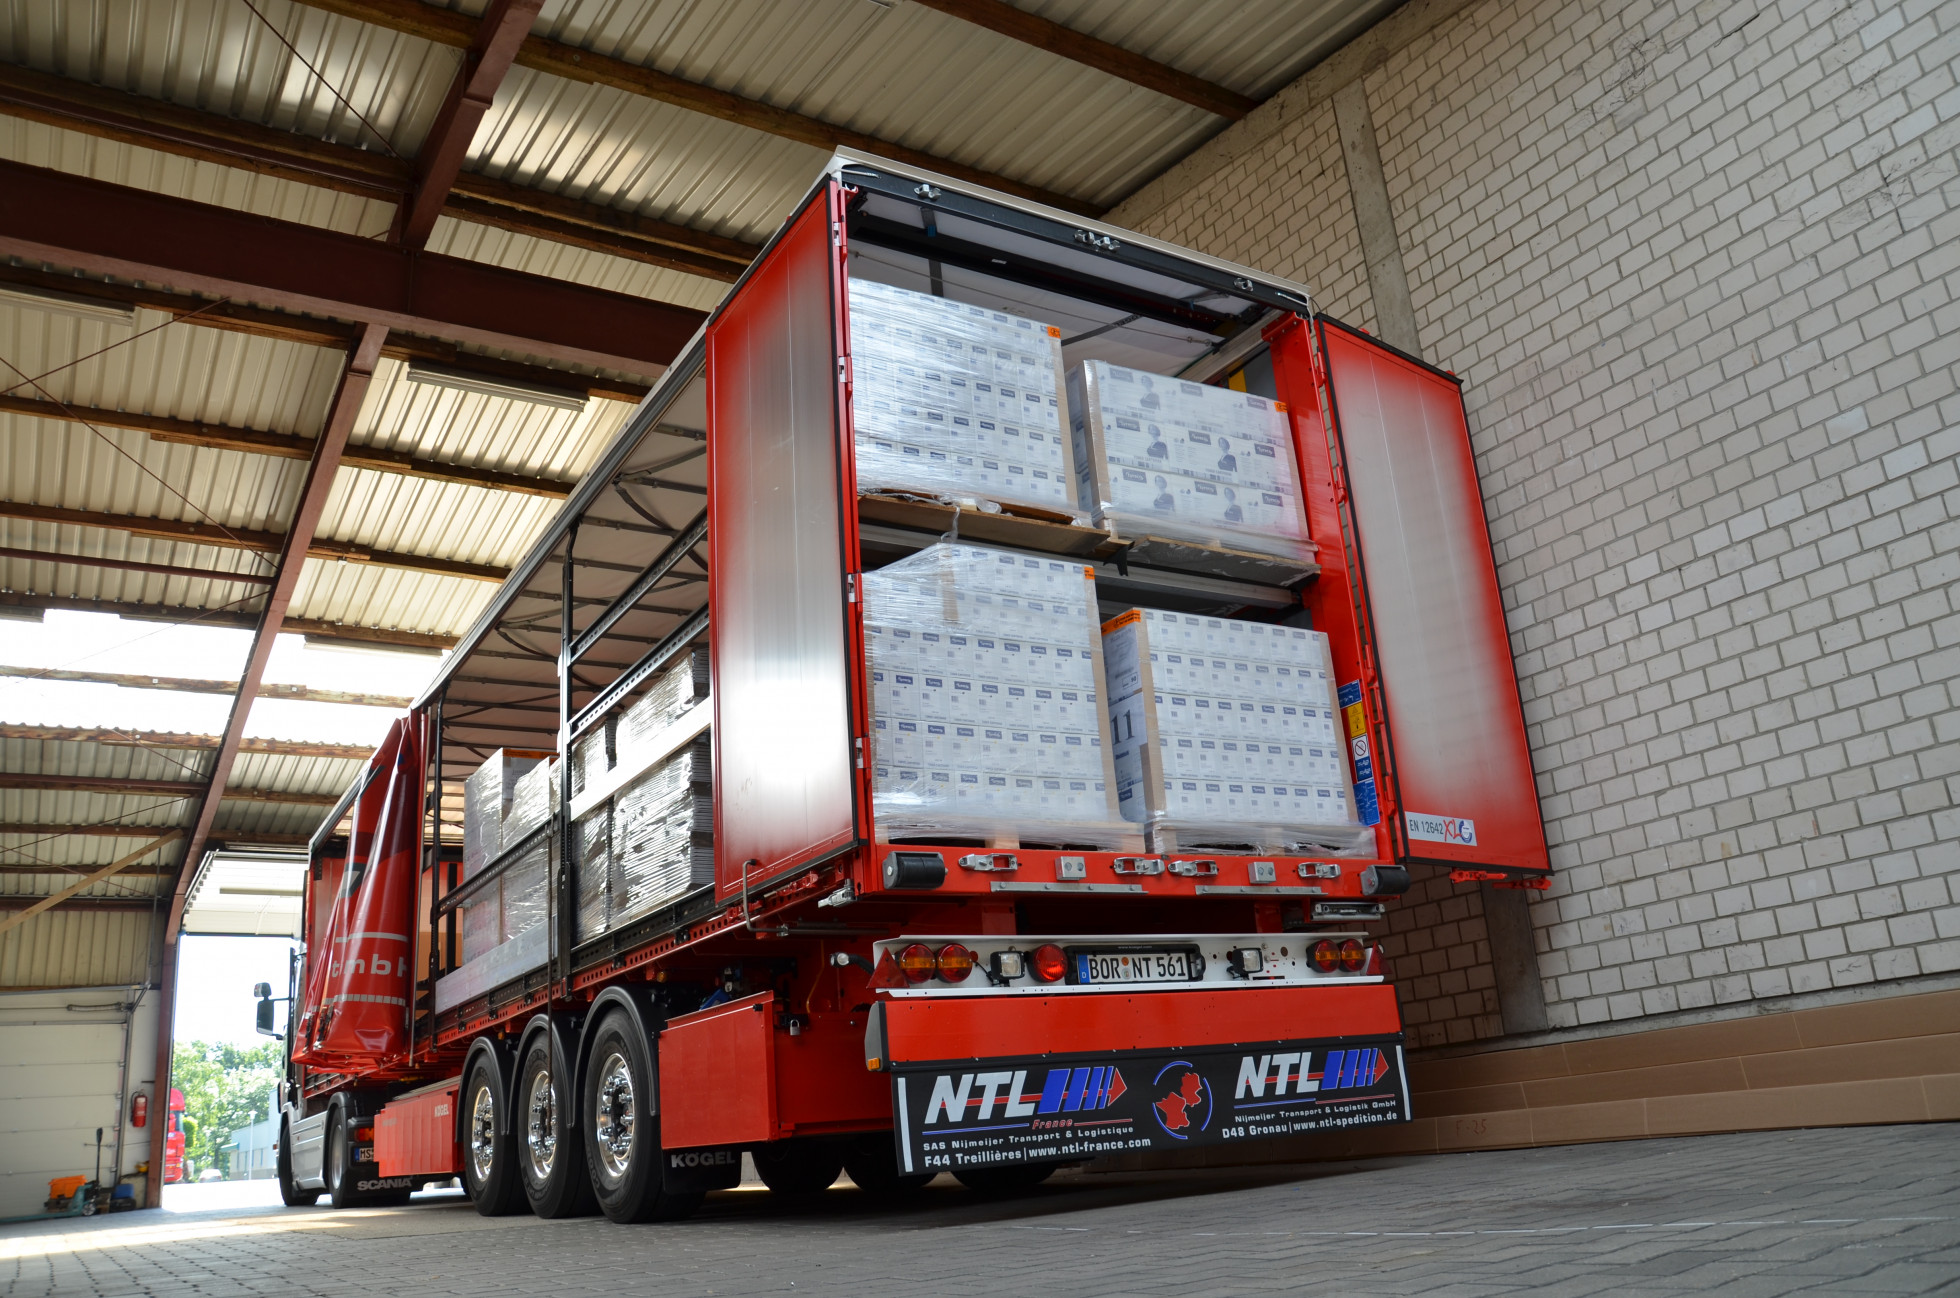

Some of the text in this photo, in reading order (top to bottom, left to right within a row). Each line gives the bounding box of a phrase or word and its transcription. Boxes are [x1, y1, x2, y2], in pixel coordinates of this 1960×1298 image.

[1409, 819, 1420, 832] EN
[1421, 821, 1444, 835] 12642
[1443, 819, 1462, 842] XL
[1089, 957, 1121, 980] BOR
[1131, 957, 1151, 978] NT
[1156, 956, 1186, 977] 561
[1234, 1051, 1320, 1099] NTL
[924, 1070, 1036, 1124] NTL
[1234, 1113, 1276, 1123] Nijmeijer
[1279, 1107, 1322, 1118] Transport
[1334, 1102, 1369, 1113] Logistik
[1372, 1100, 1397, 1109] GmbH
[1032, 1118, 1073, 1130] France
[1222, 1126, 1245, 1139] D48
[1249, 1123, 1287, 1136] Gronau
[923, 1125, 1134, 1151] SAS Nijmeijer Transport & Logistique
[671, 1151, 735, 1168] KÖGEL
[924, 1154, 951, 1167] F44
[357, 1178, 412, 1191] SCANIA
